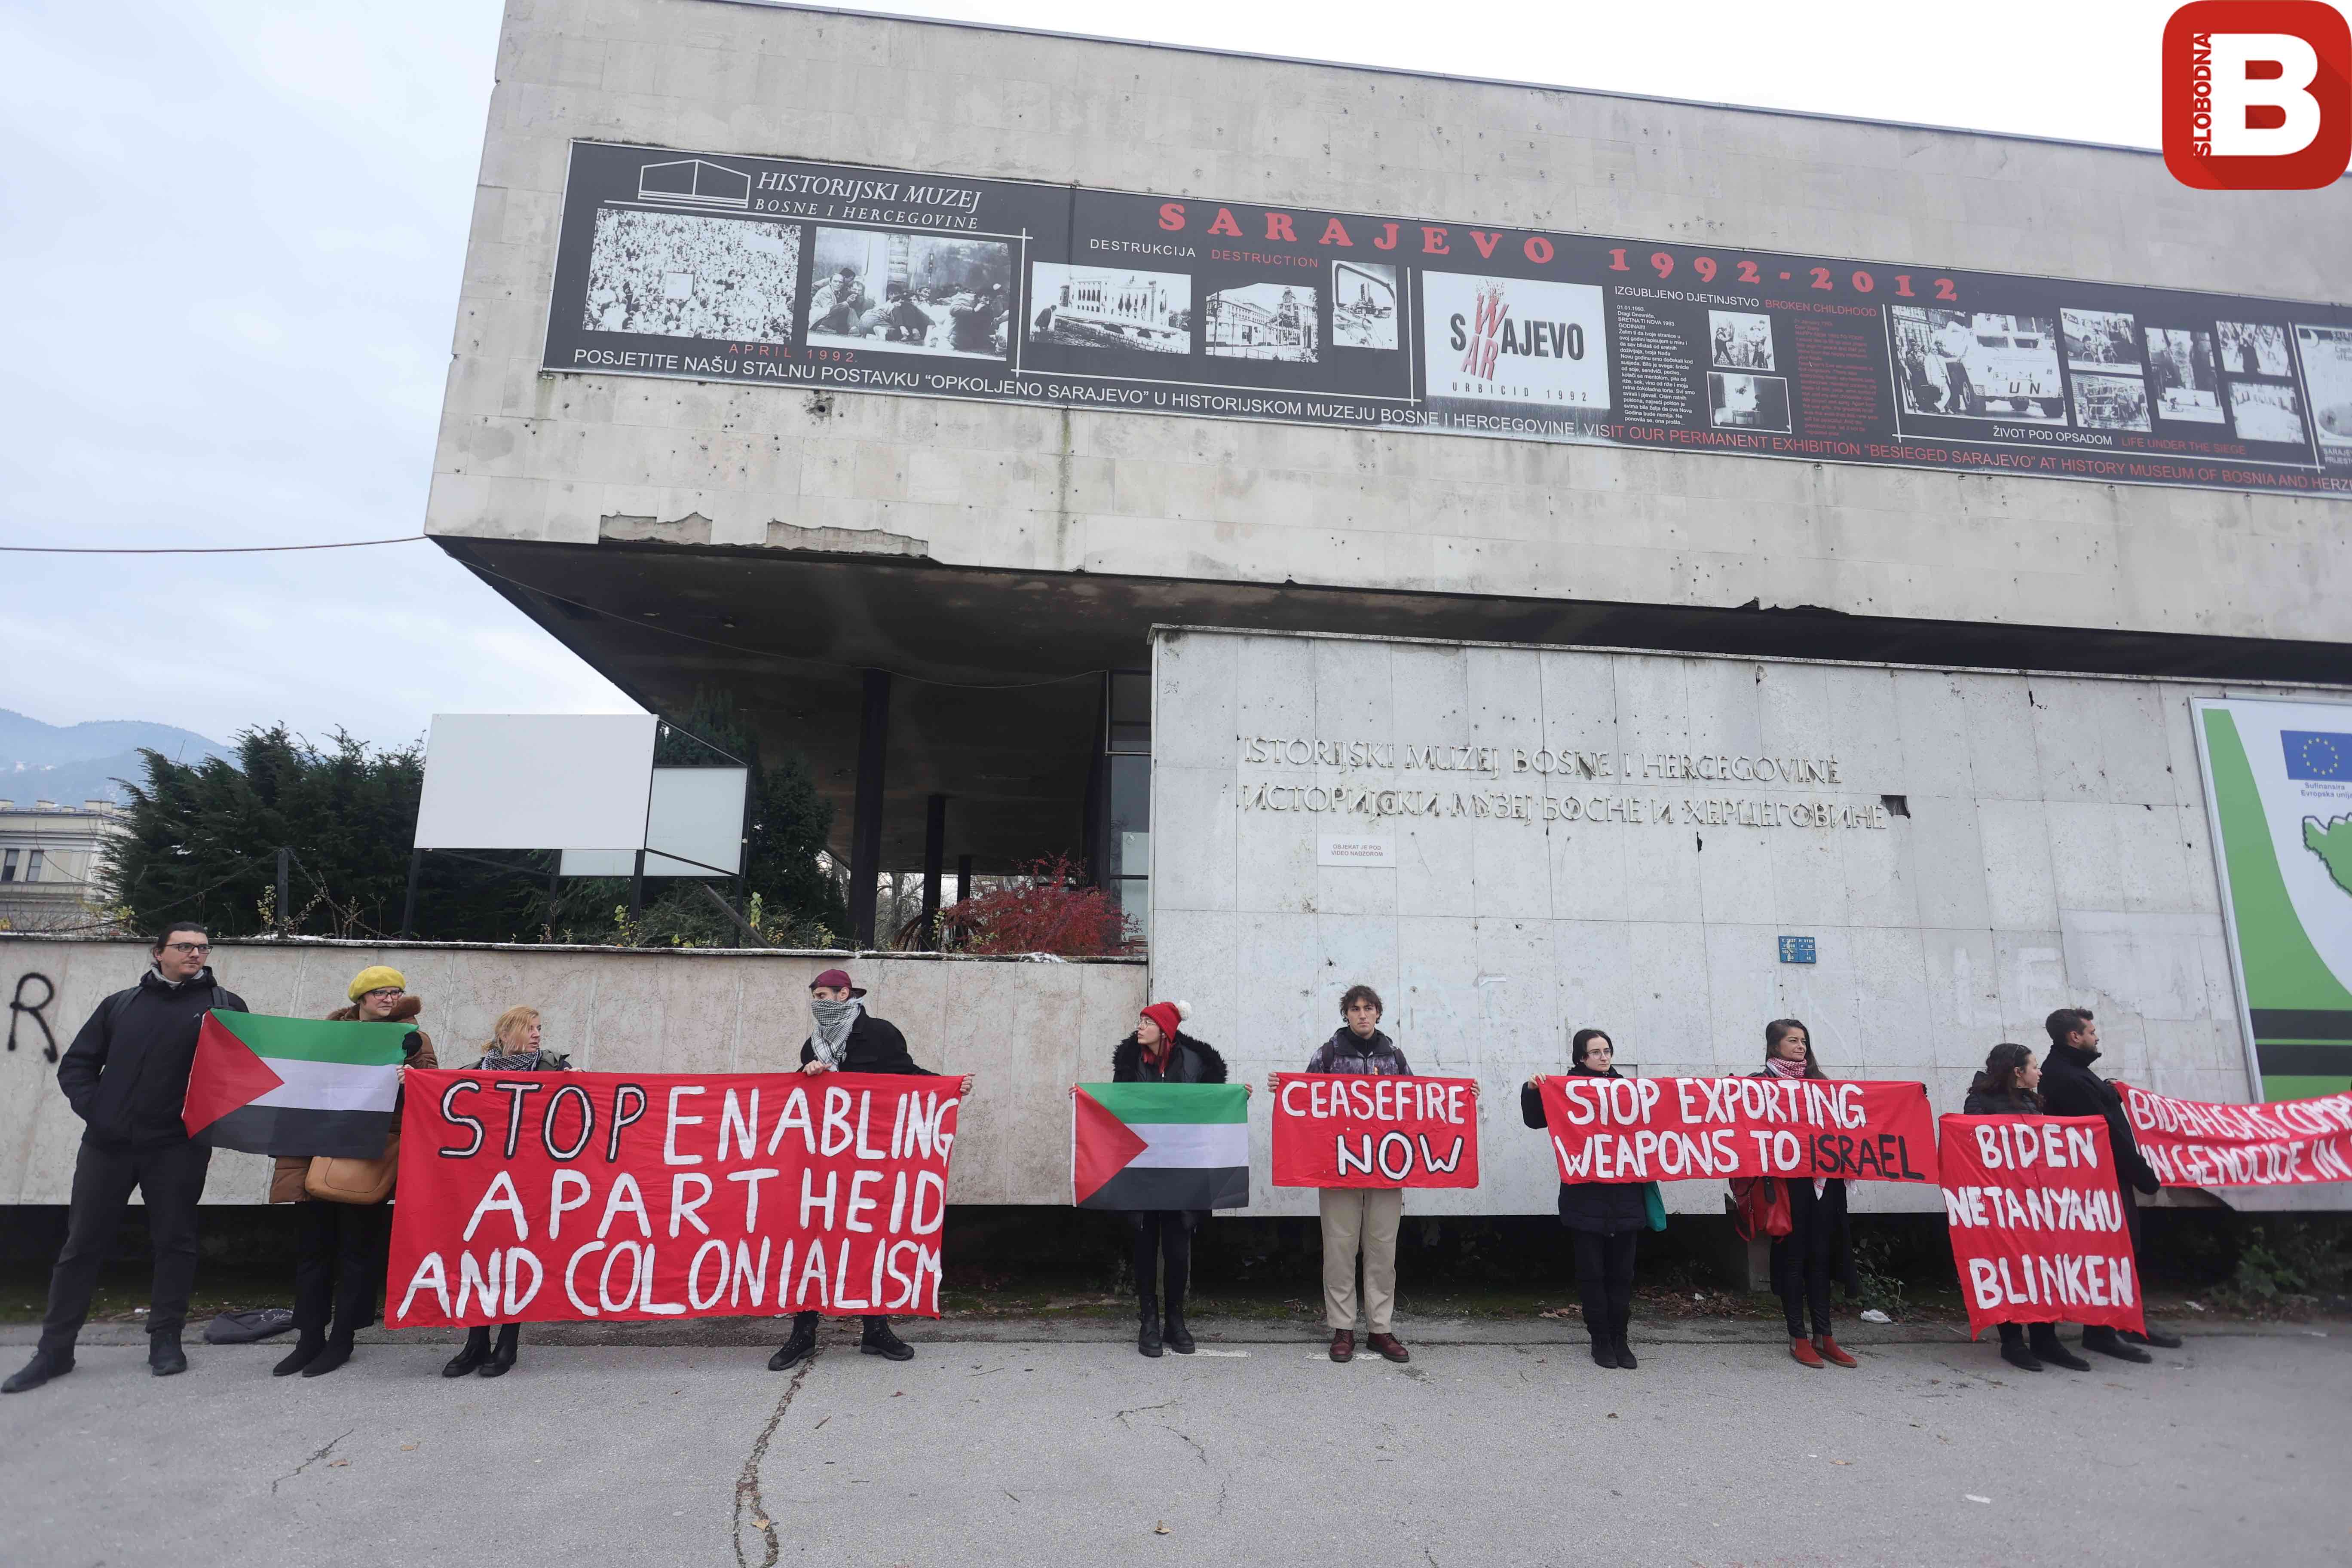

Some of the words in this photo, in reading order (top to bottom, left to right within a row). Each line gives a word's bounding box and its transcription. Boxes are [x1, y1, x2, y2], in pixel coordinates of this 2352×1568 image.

[754, 199, 818, 214] BOSNE
[827, 204, 834, 217] I
[842, 207, 977, 229] HERCEGOVINE
[756, 172, 904, 203] HISTORIJSKI
[904, 186, 982, 213] MUZEJ
[1090, 239, 1195, 257] DESTRUKCIJA
[1159, 203, 1554, 263] SARAJEVO
[1610, 249, 1957, 301] 1992-2012
[1210, 249, 1319, 268] DESTRUCTION
[1615, 286, 1683, 300] IZGUBLJENO
[1687, 293, 1759, 306] DJETINJSTVO
[1764, 300, 1811, 310] BROKEN
[1813, 304, 1877, 316] CHILDHOOD
[729, 344, 791, 358] APRIL
[807, 349, 858, 363] 1992.
[1452, 382, 1528, 397] URBICID
[1547, 390, 1586, 401] 1992
[574, 349, 678, 369] POSJETITE
[684, 356, 736, 373] NAŠU
[743, 361, 815, 378] STALNU
[822, 367, 919, 386] POSTAVKU
[925, 375, 1042, 396] “OPKOLJENO
[1048, 385, 1148, 403] SARAJEVO”
[1155, 392, 1166, 404] U
[1173, 393, 1301, 415] HISTORIJSKOM
[1308, 403, 1375, 420] MUZEJU
[1381, 409, 1440, 426] BOSNE
[1445, 413, 1450, 428] I
[1453, 413, 1575, 436] HERCEGOVINE.
[1583, 424, 1626, 438] VISIT
[1628, 426, 1665, 440] OUR
[1670, 430, 1767, 447] PERMANENT
[1773, 438, 1861, 454] EXHIBITION
[1864, 445, 1948, 461] “BESIEGED
[1953, 451, 2036, 468] SARAJEVO”
[2040, 457, 2056, 468] AT
[2062, 460, 2125, 474] HISTORY
[2128, 464, 2194, 478] MUSEUM
[2198, 468, 2217, 481] OF
[2221, 470, 2275, 484] BOSNIA
[2279, 474, 2309, 488] AND
[1993, 426, 2025, 438] ŽIVOT
[2029, 430, 2052, 440] POD
[2056, 432, 2112, 445] OPSADOM
[2122, 436, 2144, 447] LIFE
[2147, 438, 2186, 450] UNDER
[2189, 441, 2209, 451] THE
[2214, 443, 2246, 455] SIEGE
[1244, 736, 1394, 773] ISTORIJSKI
[1405, 744, 1499, 779] MUZEJ
[1513, 747, 1613, 777] BOSNE
[1624, 753, 1631, 776] I
[1642, 753, 1841, 783] HERCEGOVINE
[1243, 784, 1440, 821] ИСТОРИЈСКИ
[1451, 792, 1532, 826] МУЗЕЈ
[1543, 796, 1644, 823] БОСНЕ
[1652, 798, 1673, 823] И
[1682, 800, 1886, 829] ХЕРЦЕГОВИНЕ
[2300, 790, 2334, 798] Evropska
[9, 972, 58, 1063] R
[438, 1080, 647, 1163] STOP
[663, 1086, 960, 1165] ENABLING
[1281, 1080, 1464, 1124] CEASEFIRE
[1565, 1078, 1660, 1126] STOP
[1677, 1078, 1867, 1129] EXPORTING
[1335, 1130, 1464, 1181] NOW
[1554, 1129, 1739, 1179] WEAPONS
[1750, 1130, 1801, 1173] TO
[1808, 1133, 1926, 1180] ISRAEL
[1975, 1123, 2098, 1170] BIDEN
[2171, 1142, 2317, 1185] GENOCIDE
[1942, 1185, 2122, 1234] NETANYAHU
[397, 1247, 543, 1322] AND
[565, 1237, 943, 1316] COLONIALISM
[1969, 1254, 2134, 1311] BLINKEN
